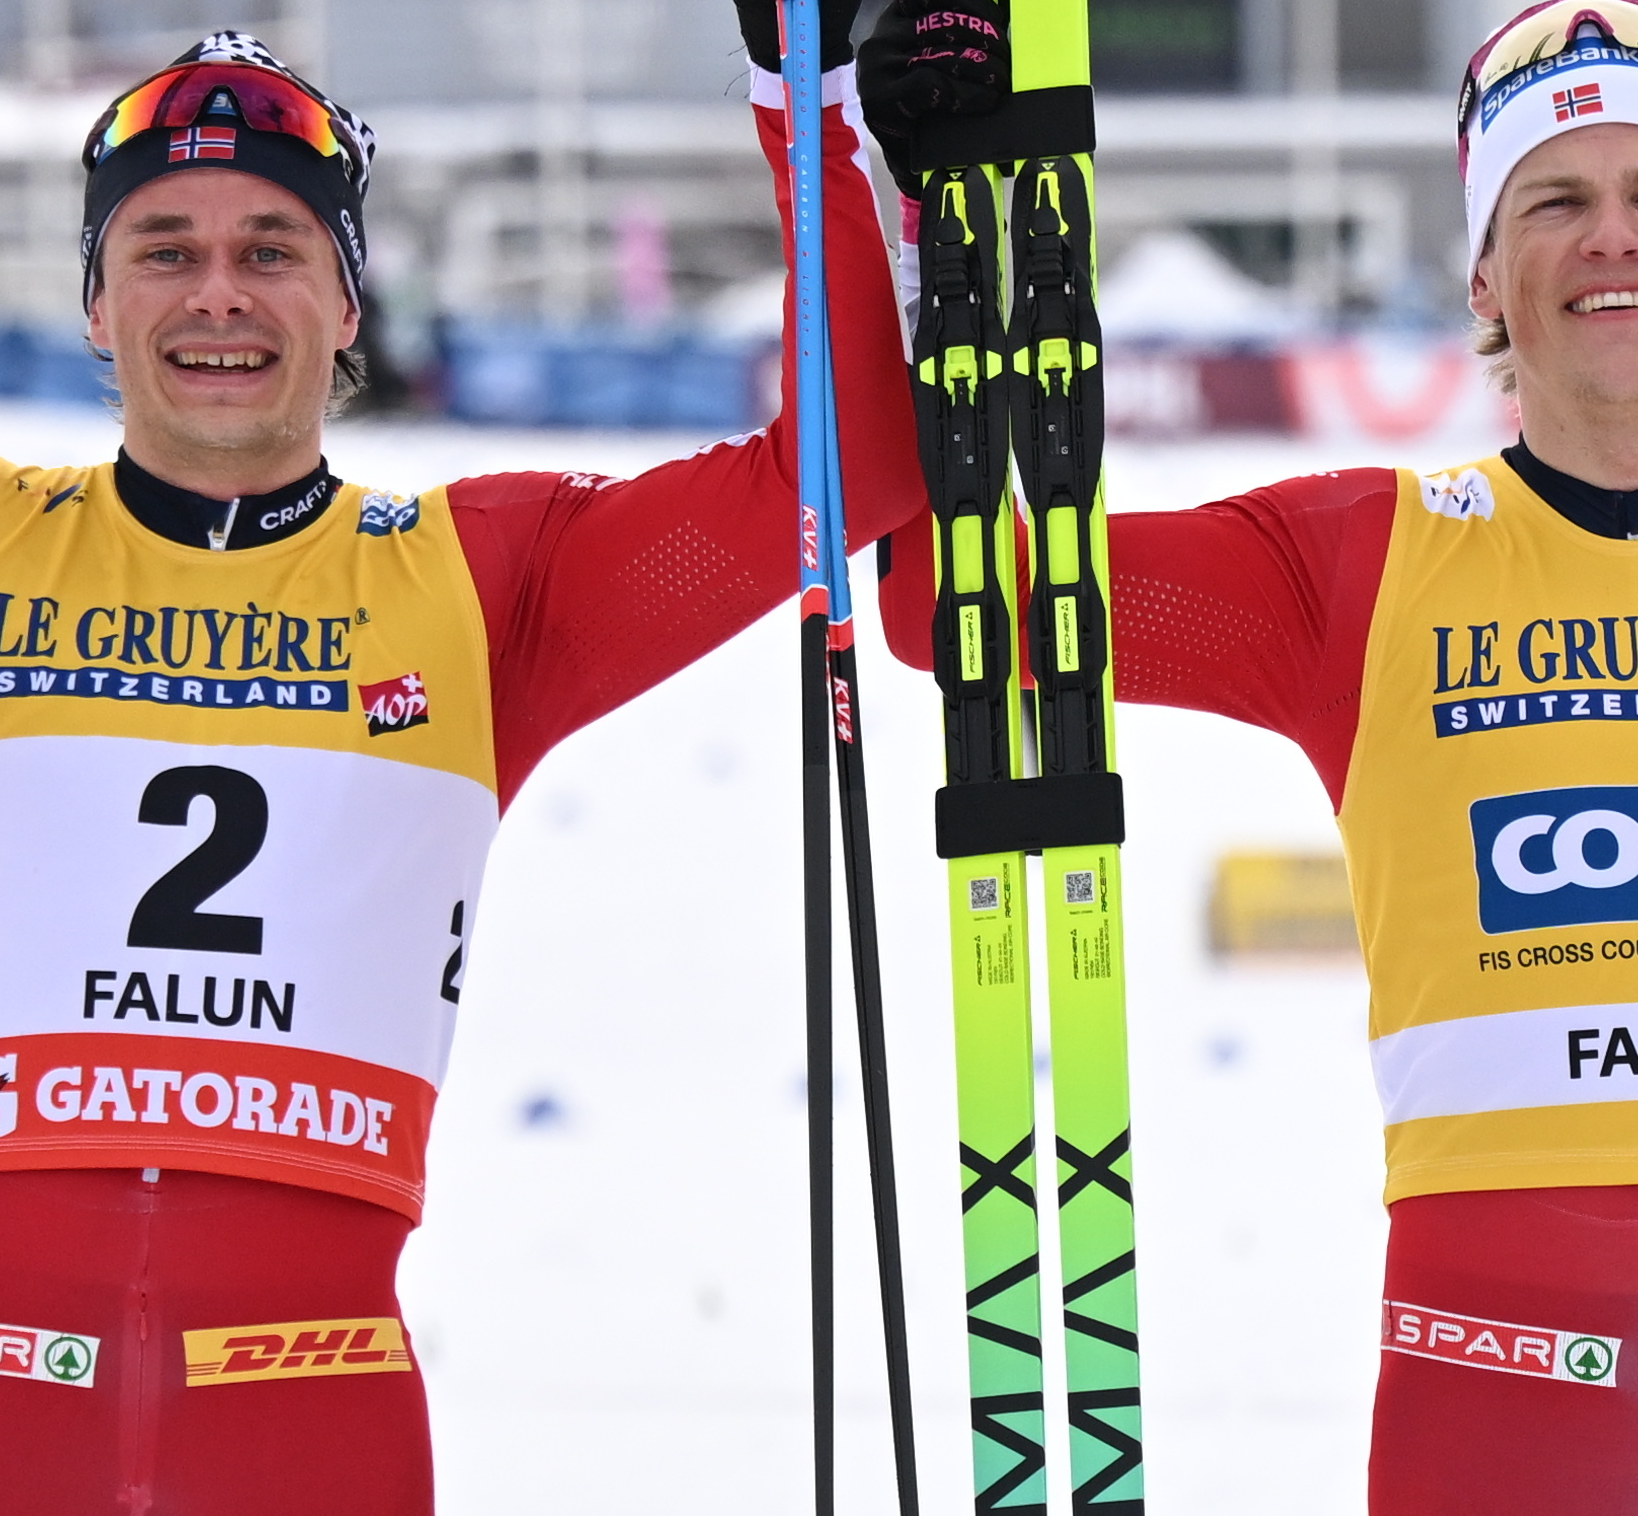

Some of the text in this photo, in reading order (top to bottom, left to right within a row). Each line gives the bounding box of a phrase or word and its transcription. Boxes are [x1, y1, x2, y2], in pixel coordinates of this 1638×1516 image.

[916, 11, 999, 40] HESTRA
[340, 209, 363, 278] CRAFT
[259, 481, 325, 532] CRAFT
[802, 504, 818, 571] KV+
[1433, 620, 1501, 694] LE
[834, 677, 852, 744] KV+
[126, 765, 270, 955] 2
[1479, 949, 1513, 973] FIS
[1516, 942, 1594, 968] CROSS
[82, 970, 296, 1032] FALUN
[36, 1066, 393, 1157] GATORADE
[959, 1122, 1047, 1509] MAX
[1056, 1120, 1144, 1505] MAX
[1395, 1316, 1553, 1367] SPAR
[221, 1328, 389, 1373] DHL
